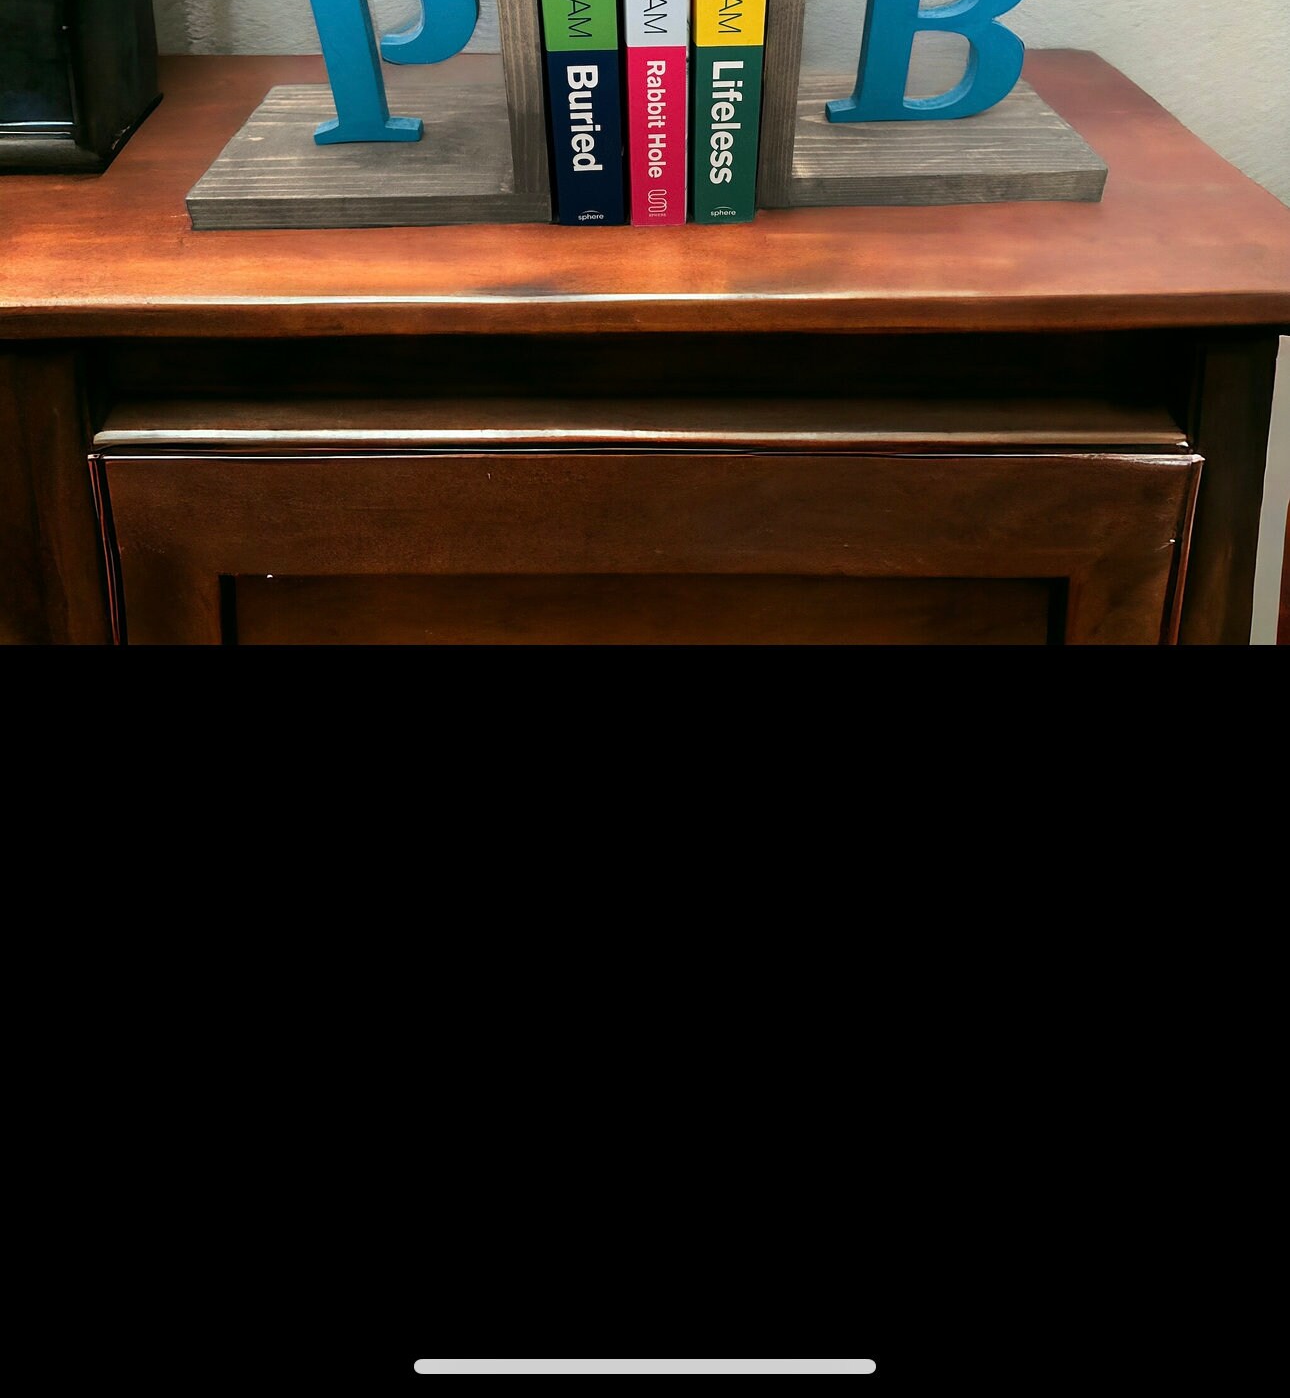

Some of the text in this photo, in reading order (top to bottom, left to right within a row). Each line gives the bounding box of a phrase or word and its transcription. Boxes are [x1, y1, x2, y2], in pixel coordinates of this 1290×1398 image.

[566, 64, 603, 172] Buried
[646, 60, 667, 178] Rabbit Hole
[709, 60, 744, 185] Lifeless
[578, 213, 604, 221] sphere
[710, 209, 736, 217] sphere
